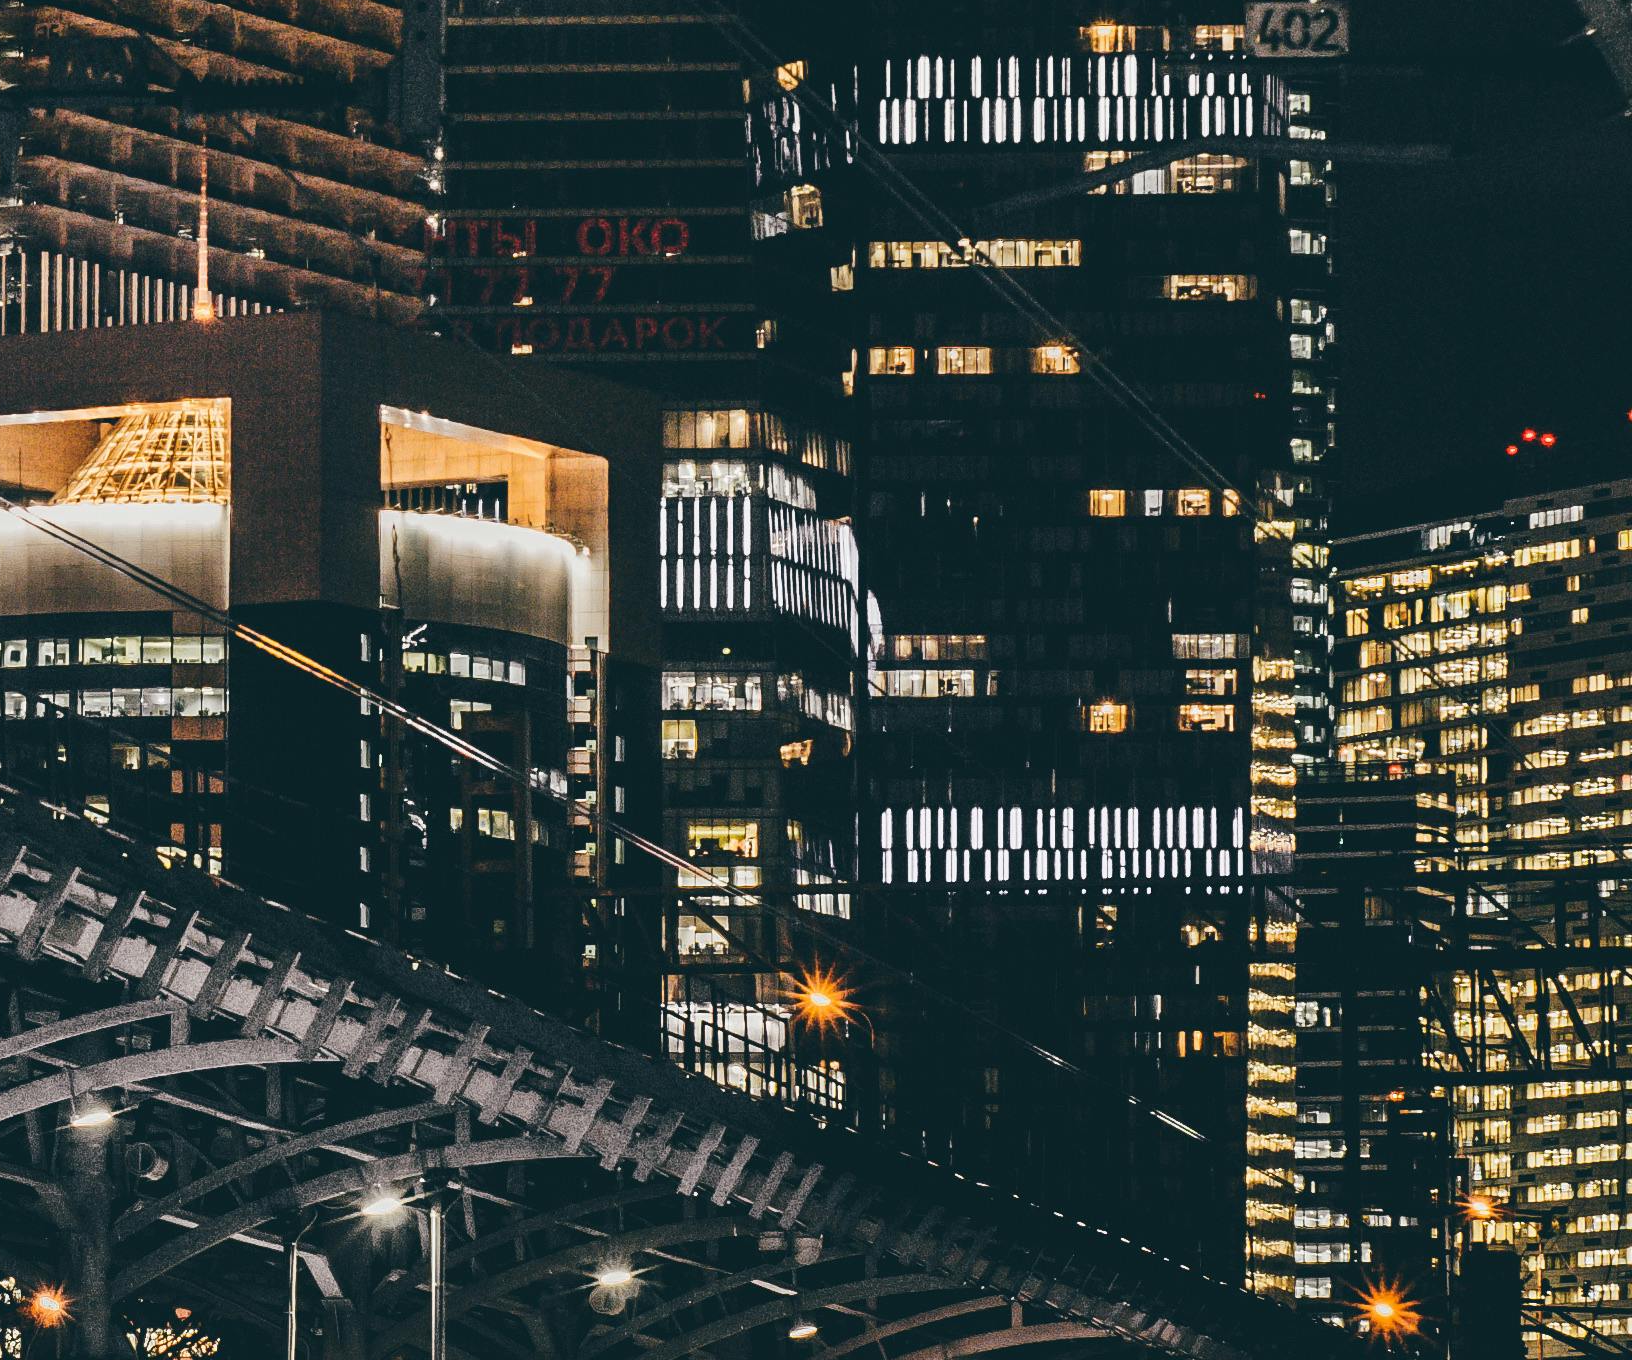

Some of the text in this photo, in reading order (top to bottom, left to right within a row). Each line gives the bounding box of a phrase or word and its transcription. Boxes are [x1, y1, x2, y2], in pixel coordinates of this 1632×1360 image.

[1260, 9, 1339, 51] 402
[576, 218, 689, 256] ОКО
[554, 267, 617, 304] 77
[496, 317, 728, 351] ПОДАРОК
